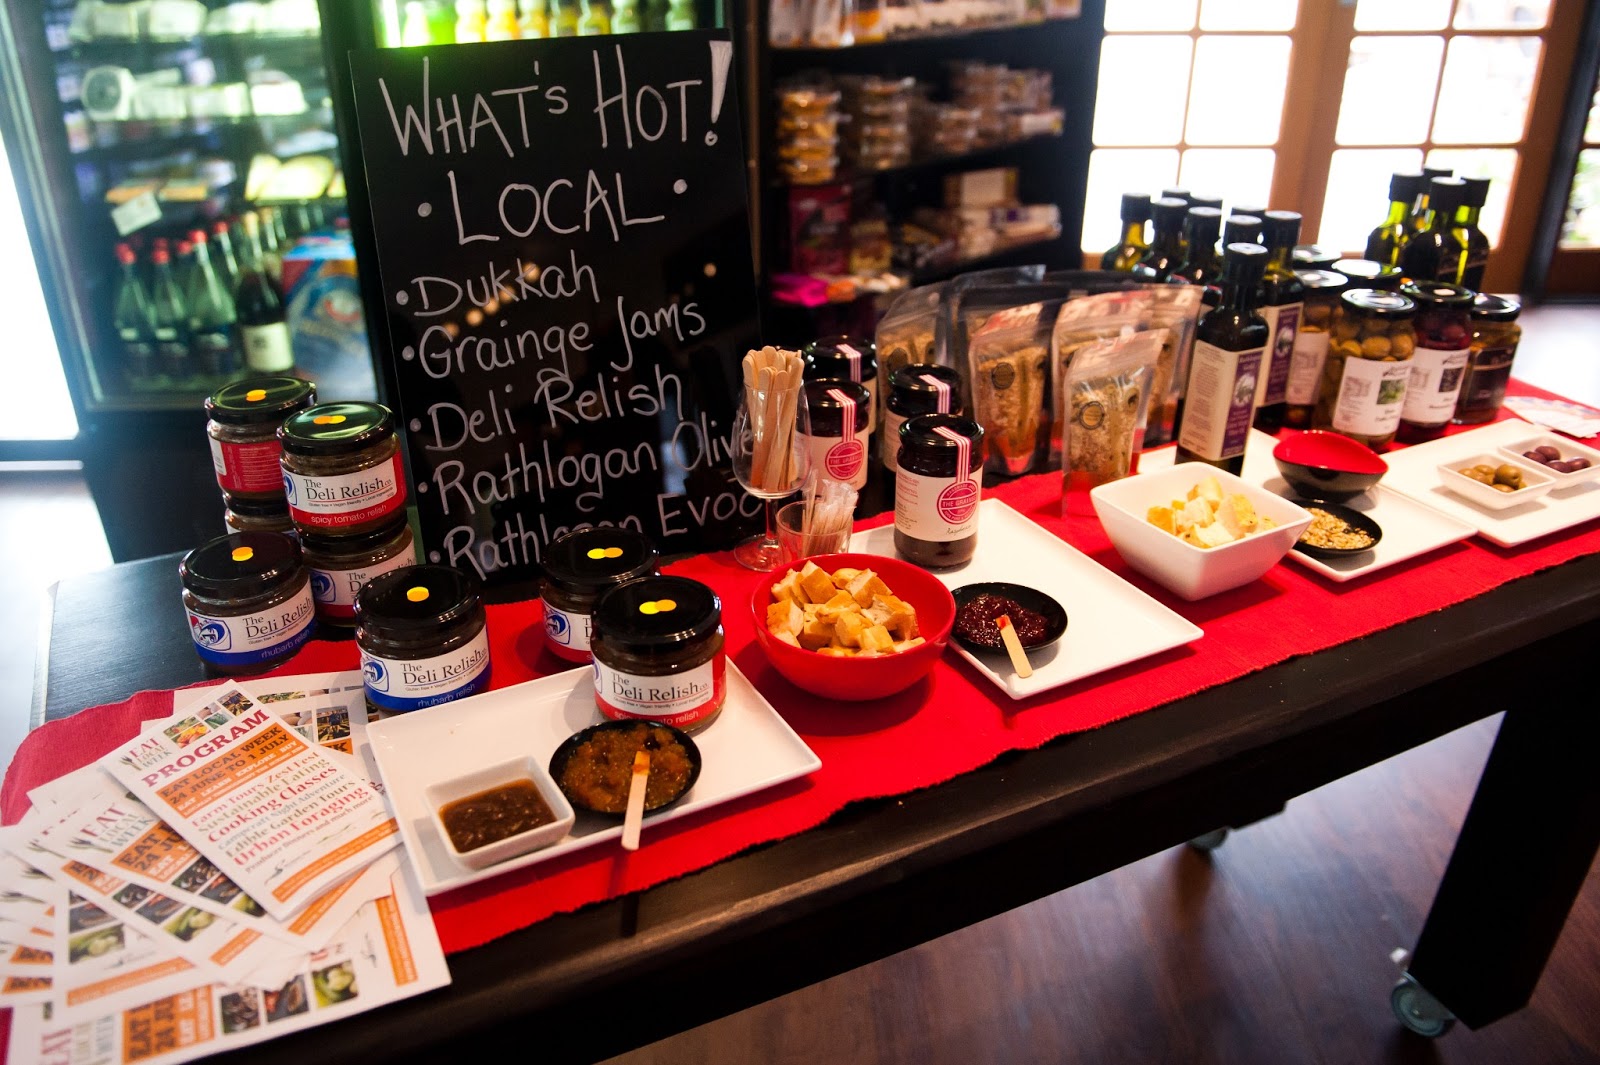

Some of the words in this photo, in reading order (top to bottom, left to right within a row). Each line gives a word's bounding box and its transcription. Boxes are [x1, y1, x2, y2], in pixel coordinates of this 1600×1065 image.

[593, 40, 733, 149] HOT!
[447, 169, 665, 245] LOCAL
[419, 319, 594, 383] Grainge
[610, 296, 706, 372] Jams
[425, 382, 517, 450] Deli
[534, 364, 684, 428] Relish
[303, 479, 321, 488] The
[306, 488, 335, 500] Deli
[340, 478, 384, 499] Relish
[432, 440, 658, 514] Rathlogan
[311, 515, 332, 524] spicy
[334, 511, 365, 523] tomato
[367, 505, 387, 517] relish
[346, 572, 367, 581] The
[242, 616, 264, 627] The
[246, 619, 278, 638] Deli
[261, 641, 294, 658] rhubarb
[400, 663, 423, 672] The
[403, 670, 437, 684] Deli
[441, 650, 481, 678] Relish
[611, 672, 629, 686] The
[418, 694, 454, 707] rhubarb
[456, 683, 475, 698] relish
[613, 681, 642, 700] Deli
[649, 682, 699, 702] Relish
[675, 710, 699, 723] relish
[142, 709, 270, 787] PROGRAM
[162, 778, 190, 797] EAT
[193, 753, 241, 779] LOCAL
[241, 727, 282, 752] WEEK
[171, 792, 187, 804] 24
[191, 771, 225, 793] JUNE
[226, 760, 246, 771] TO
[260, 734, 288, 754] JULY
[80, 803, 125, 837] EAT
[192, 804, 228, 827] Farm
[229, 783, 265, 804] Tours
[198, 783, 280, 832] Sustainable
[208, 799, 282, 842] Cooking
[280, 767, 337, 800] Classes
[270, 801, 319, 829] Garden
[319, 782, 355, 802] Tours
[234, 829, 291, 866] Urban
[290, 787, 368, 831] Foraging
[119, 833, 161, 866] EAT
[135, 853, 161, 871] 24
